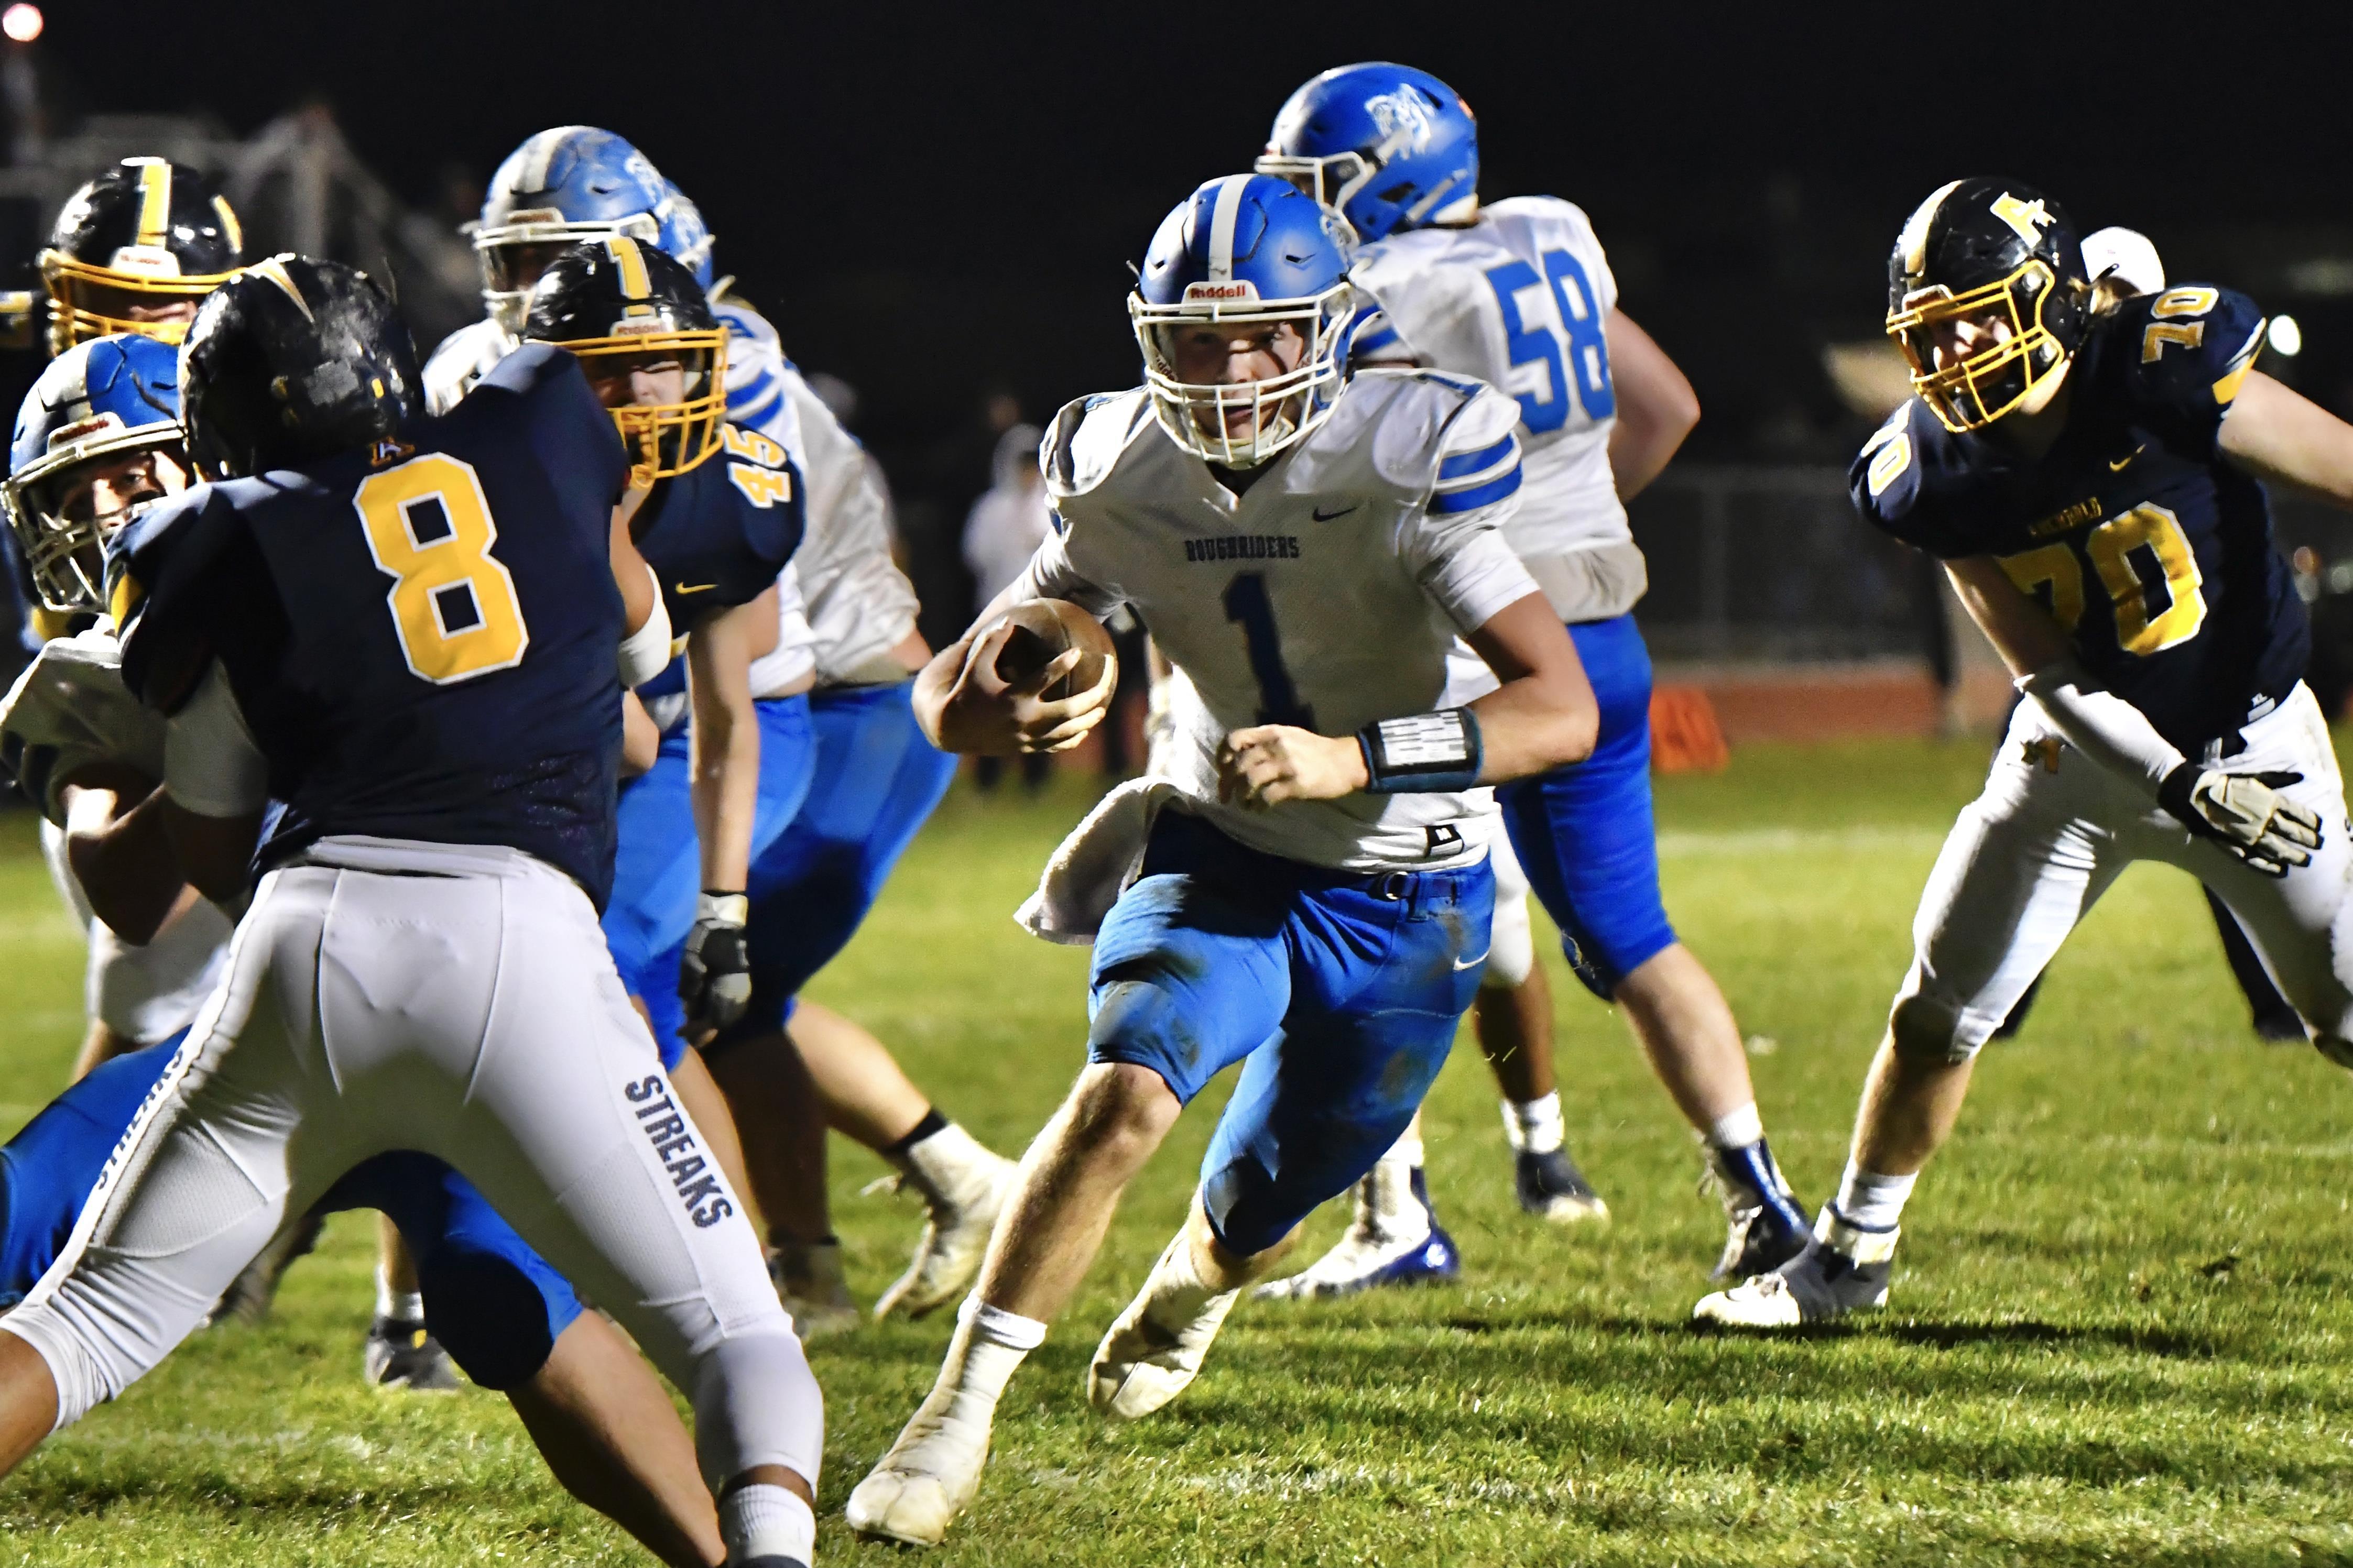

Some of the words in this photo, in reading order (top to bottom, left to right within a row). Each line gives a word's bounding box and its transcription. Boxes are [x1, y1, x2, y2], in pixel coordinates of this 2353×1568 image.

[1486, 248, 1615, 435] 58
[2141, 287, 2219, 364] 70
[721, 423, 792, 509] 45
[352, 451, 529, 686] 8
[1185, 535, 1300, 562] ROUGHRIDERS
[1992, 500, 2208, 657] 70
[1221, 569, 1319, 734] 1
[624, 1074, 733, 1229] STREAKS
